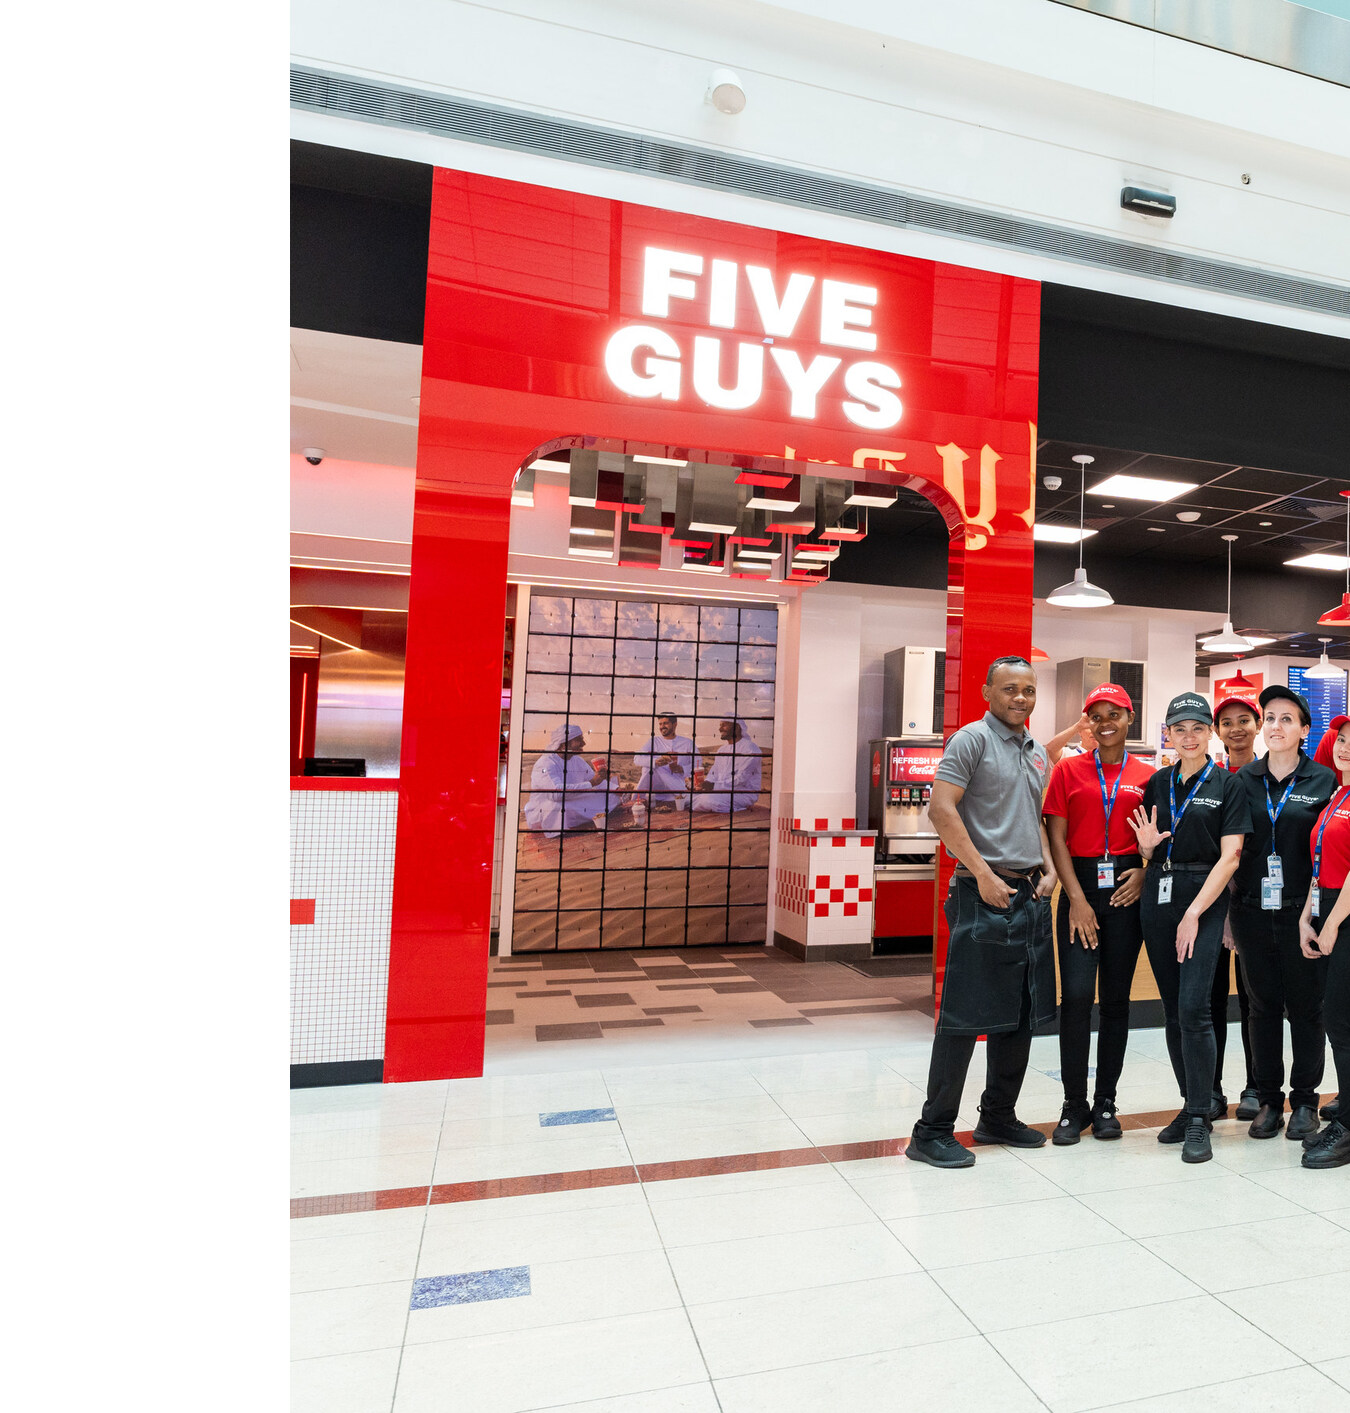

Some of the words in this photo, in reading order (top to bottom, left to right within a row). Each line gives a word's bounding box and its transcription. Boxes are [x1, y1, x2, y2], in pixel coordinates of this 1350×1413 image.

[641, 246, 878, 352] FIVE
[605, 325, 903, 430] GUYS
[1187, 698, 1205, 707] GUYS
[893, 757, 930, 765] REFRESH
[1205, 797, 1222, 806] GUYS
